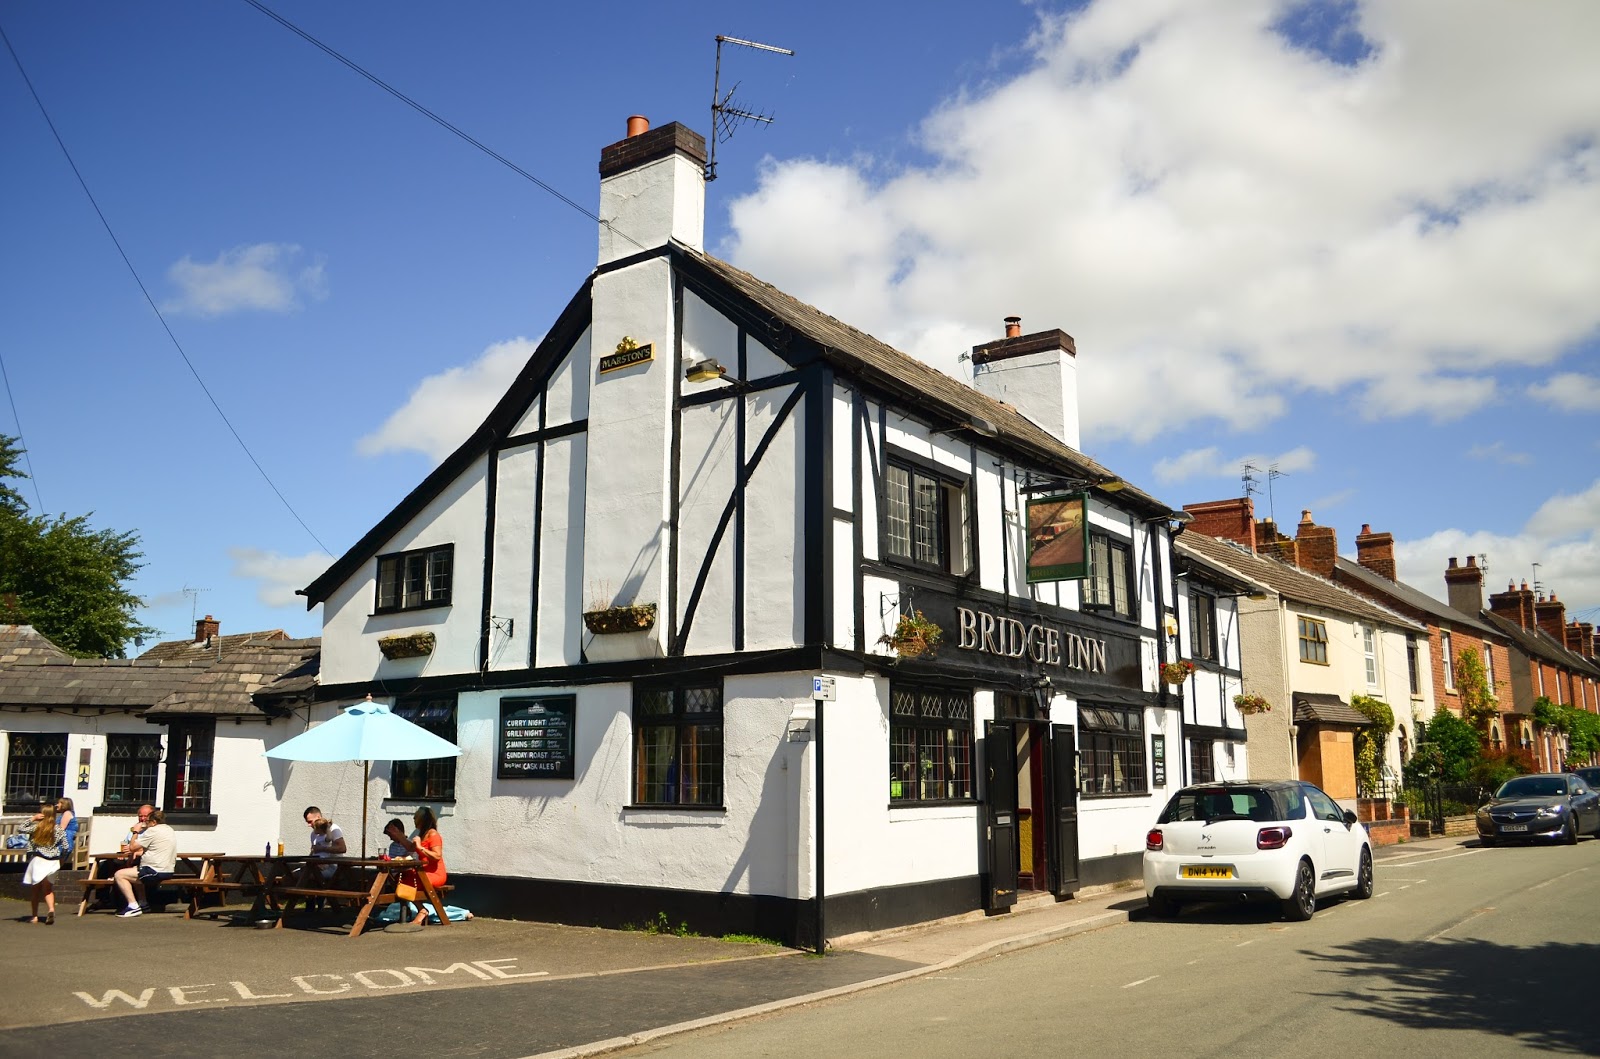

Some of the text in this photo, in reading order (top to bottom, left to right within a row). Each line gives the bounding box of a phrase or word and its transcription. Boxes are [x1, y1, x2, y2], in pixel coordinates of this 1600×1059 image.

[602, 348, 650, 368] MARSTON'S
[957, 606, 1107, 674] BRIDGE INN
[506, 729, 523, 737] GRILL
[524, 729, 543, 737] NIGHT
[506, 751, 528, 759] SUNDAY
[528, 751, 548, 759] ROAST
[523, 762, 538, 770] CASK
[539, 762, 555, 770] ALES
[1188, 867, 1207, 877] DN14
[72, 957, 549, 1009] WELCOME
